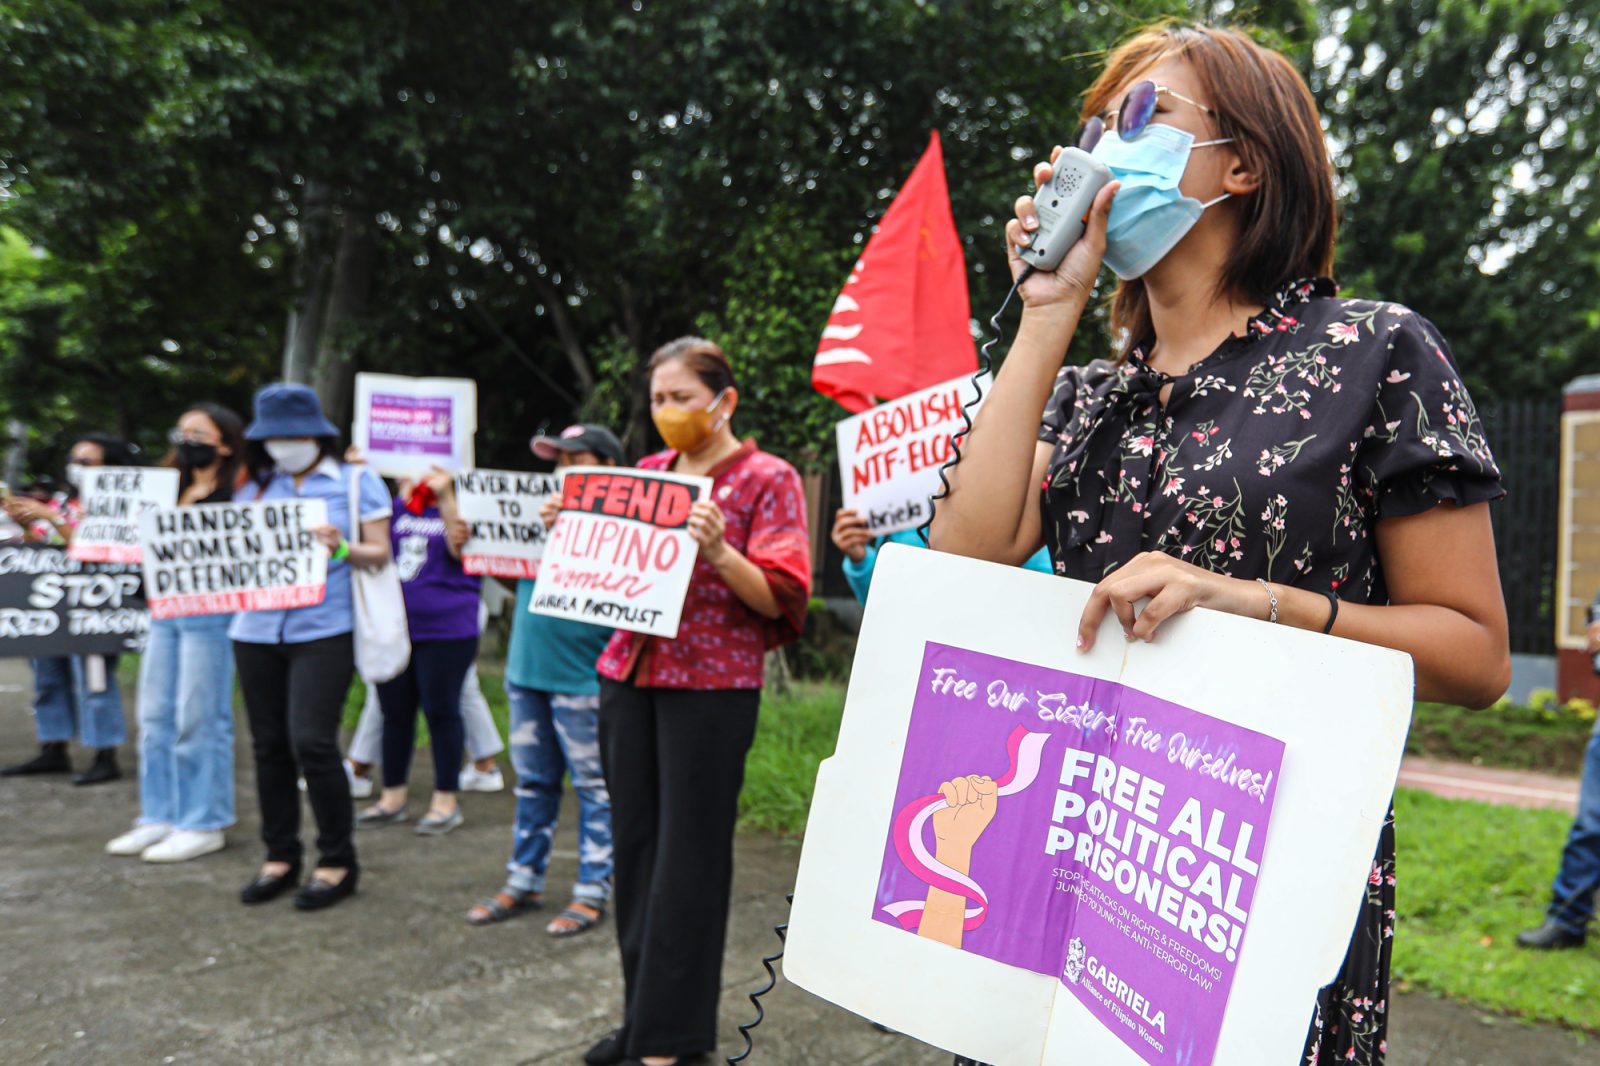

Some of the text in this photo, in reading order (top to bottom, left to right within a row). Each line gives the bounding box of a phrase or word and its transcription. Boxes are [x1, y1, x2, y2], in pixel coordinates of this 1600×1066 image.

[855, 389, 962, 452] ABOLISH
[459, 473, 508, 494] NEVER
[497, 498, 521, 518] TO
[561, 473, 692, 528] EFEND
[151, 533, 262, 563] WOMEN
[275, 530, 313, 552] HR
[156, 504, 304, 535] HANDS OFF
[551, 517, 681, 573] FILIPINO
[28, 573, 142, 609] STOP
[0, 607, 60, 639] RED
[931, 668, 978, 700] Free
[987, 680, 1030, 713] Our
[1125, 717, 1162, 753] Free
[1167, 732, 1273, 805] Ourselves!
[1059, 747, 1259, 877] FREE ALL
[1051, 788, 1248, 925] POLITICAL
[1045, 825, 1243, 963] PRISONERS!
[1051, 867, 1081, 881] STOP
[1089, 884, 1119, 912] ATTACKS
[1117, 905, 1131, 921] ON
[1131, 913, 1160, 941] RIGHTS
[1161, 934, 1167, 945] &
[1168, 938, 1223, 982] FREEDOMS!
[1096, 904, 1116, 925] JUNK
[1116, 919, 1132, 937] THE
[1130, 931, 1188, 976] ANTI-TERROR
[1188, 969, 1213, 993] LAW!
[1080, 976, 1164, 1054] Alliance of Filipino Women
[1086, 955, 1166, 1035] GABRIELA
